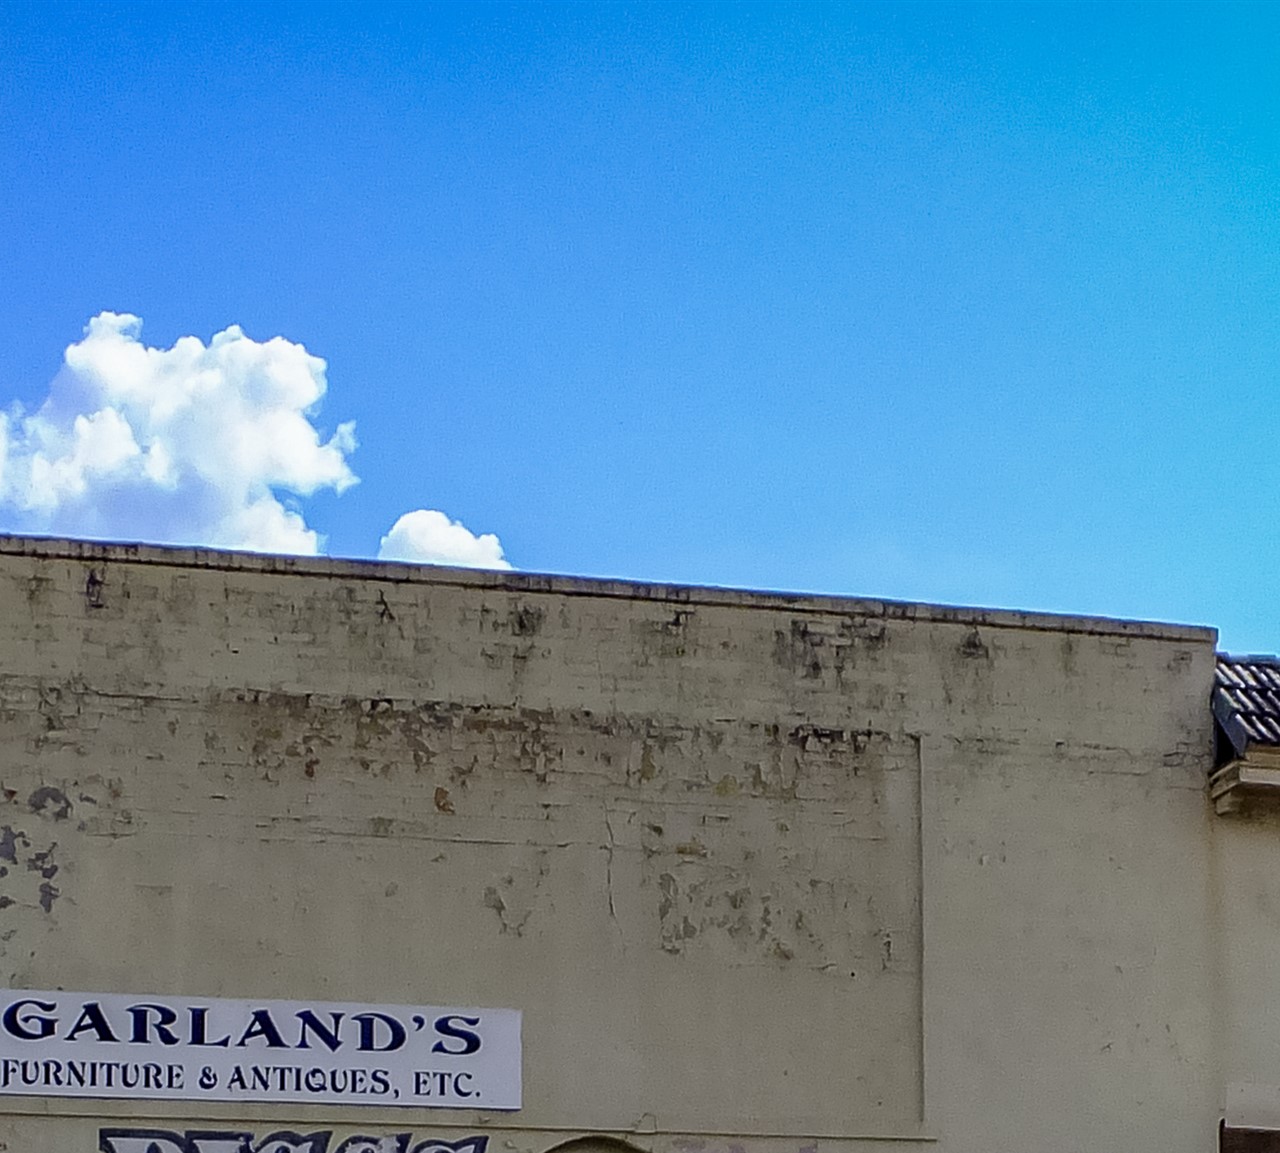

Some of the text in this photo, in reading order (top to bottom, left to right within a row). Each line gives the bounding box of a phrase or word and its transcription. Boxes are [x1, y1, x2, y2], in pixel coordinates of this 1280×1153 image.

[1, 998, 483, 1056] GARLAND'S
[0, 1058, 483, 1100] FURNITURE & ANTIQUES, ETC.
